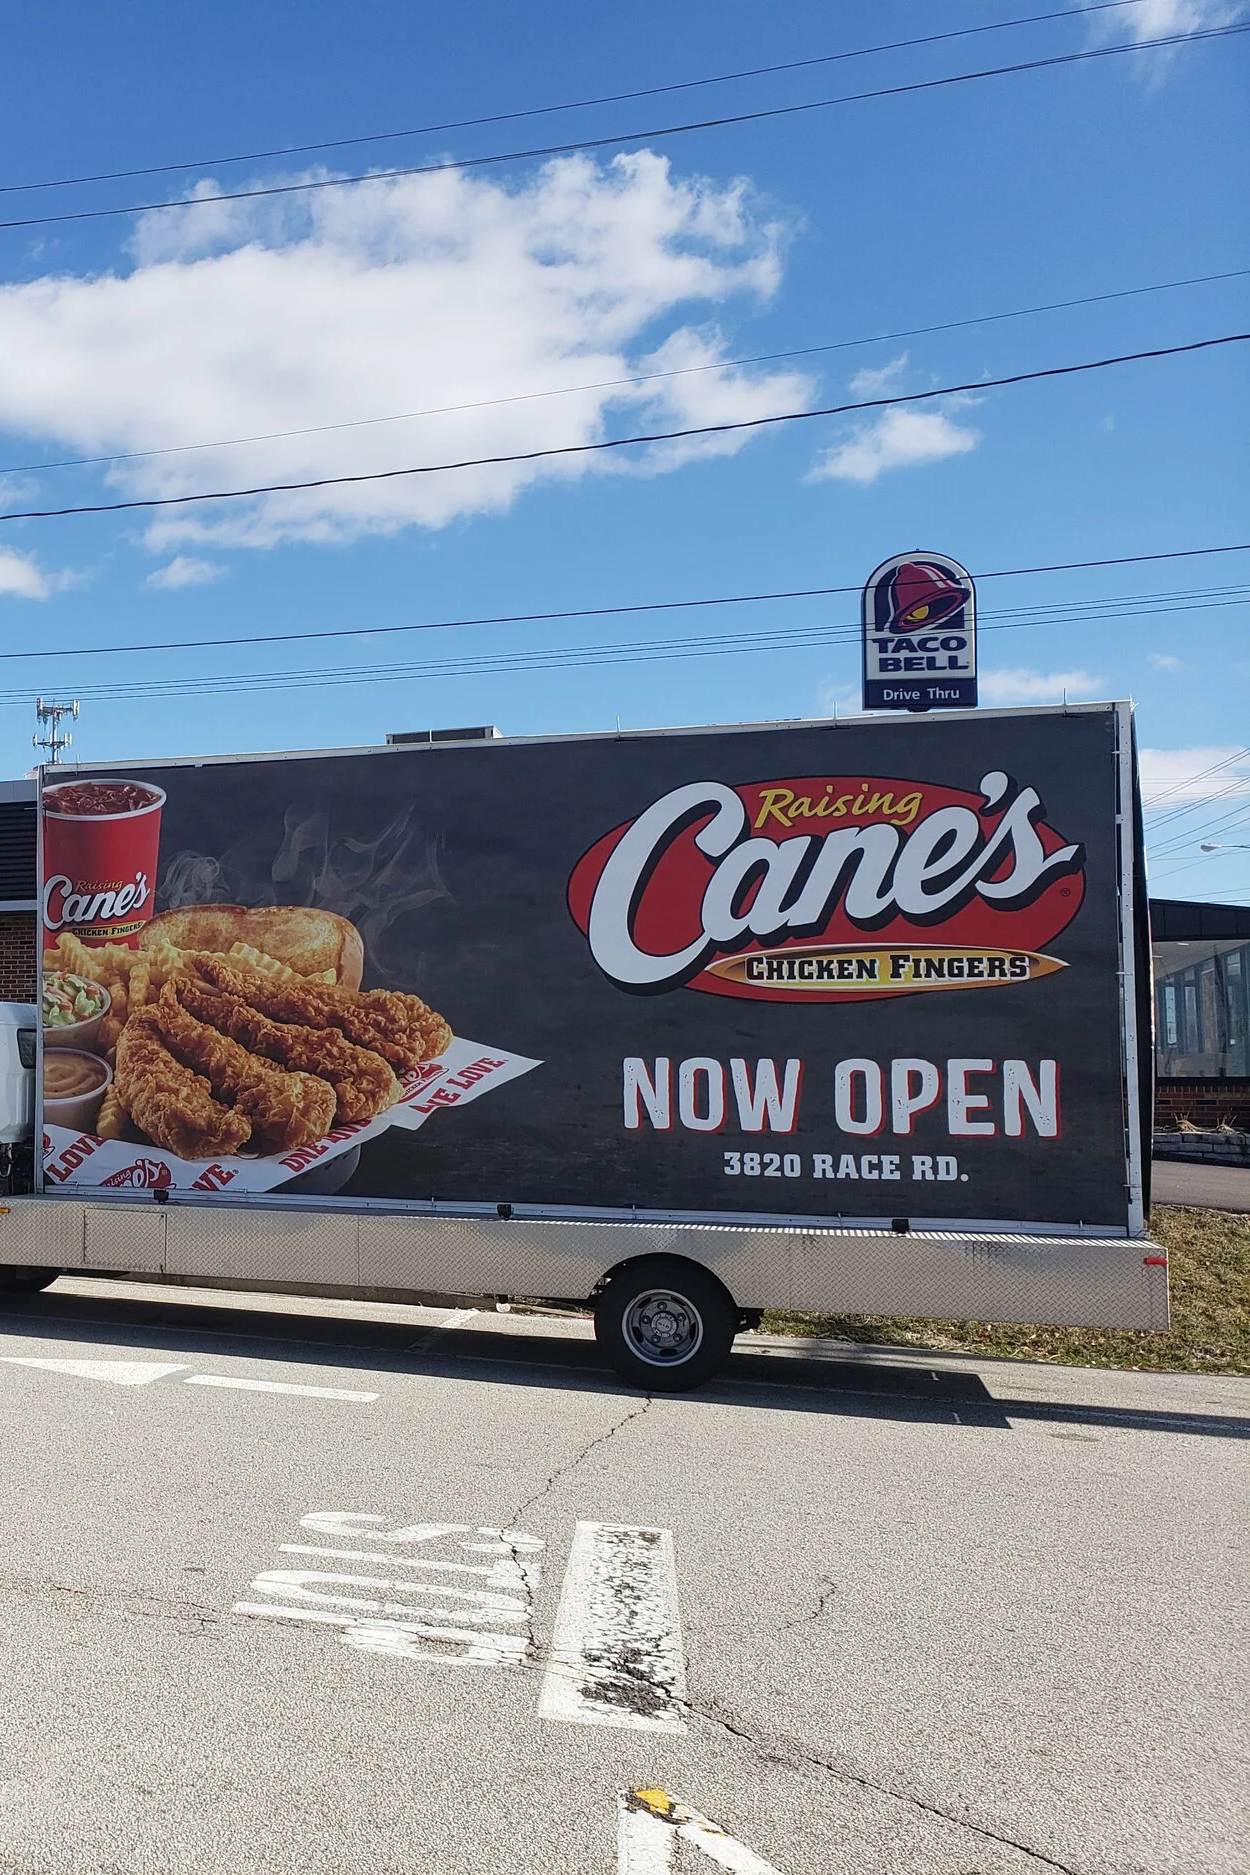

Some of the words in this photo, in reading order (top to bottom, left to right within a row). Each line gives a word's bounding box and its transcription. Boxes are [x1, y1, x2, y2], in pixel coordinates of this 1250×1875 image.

[871, 636, 968, 654] TACO
[878, 655, 969, 673] BELL
[883, 688, 921, 701] Drive
[927, 687, 960, 699] Thru
[754, 784, 924, 829] Raising
[75, 879, 124, 893] Raising
[588, 771, 1082, 986] Cane's
[43, 871, 151, 930] Cane's
[72, 927, 109, 937] CHICKEN
[111, 921, 142, 936] FINGERS
[745, 954, 879, 982] CHICKEN
[889, 953, 1031, 981] FINGERS
[622, 1057, 803, 1135] NOW
[834, 1058, 1061, 1138] OPEN
[723, 1151, 801, 1178] 3820
[812, 1153, 901, 1181] RACE
[913, 1155, 969, 1183] RD.
